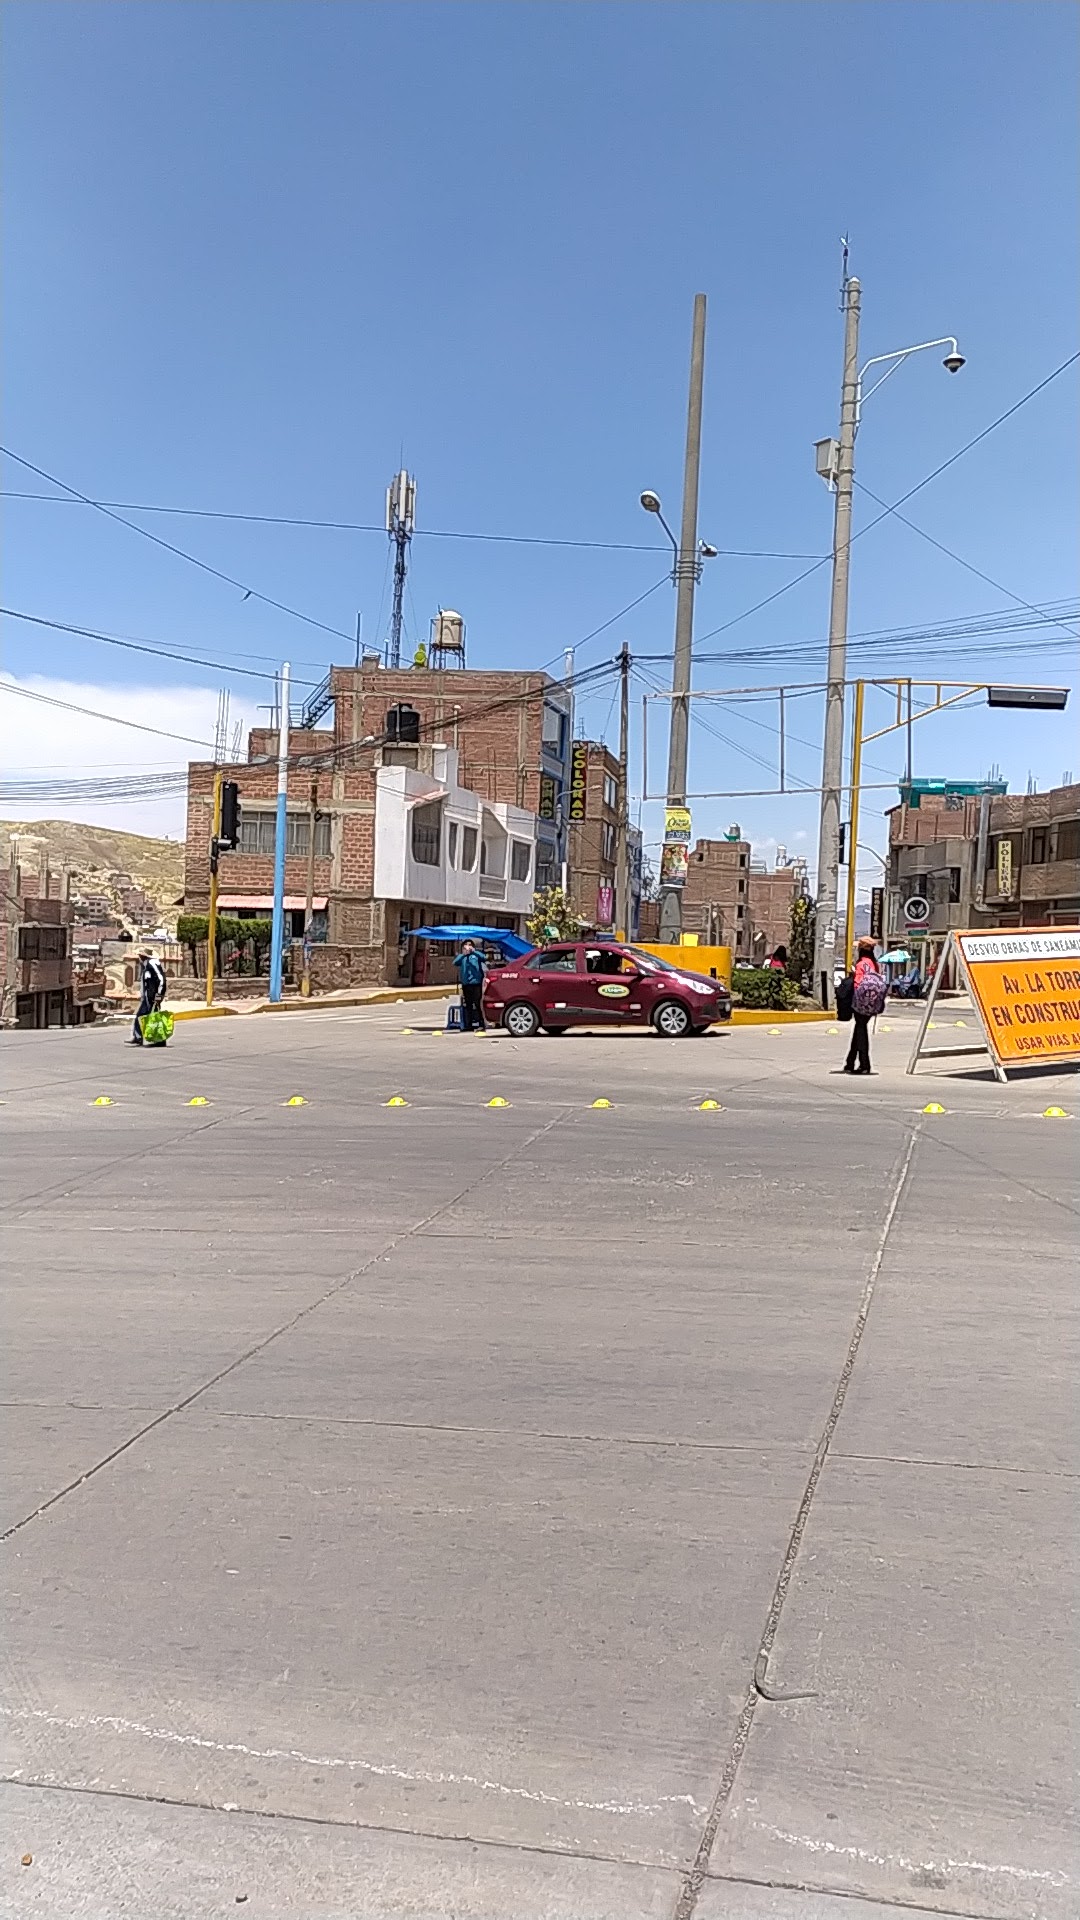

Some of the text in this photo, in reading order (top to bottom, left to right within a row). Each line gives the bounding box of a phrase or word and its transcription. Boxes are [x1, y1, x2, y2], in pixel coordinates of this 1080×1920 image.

[571, 750, 587, 819] COLORAO
[968, 938, 1080, 956] DESVIO OBRAS DE SANEAMI
[1025, 972, 1046, 993] LA
[991, 1000, 1080, 1027] EN CONSTRU
[1015, 1035, 1046, 1051] USAR
[1045, 1033, 1071, 1048] VIAS
